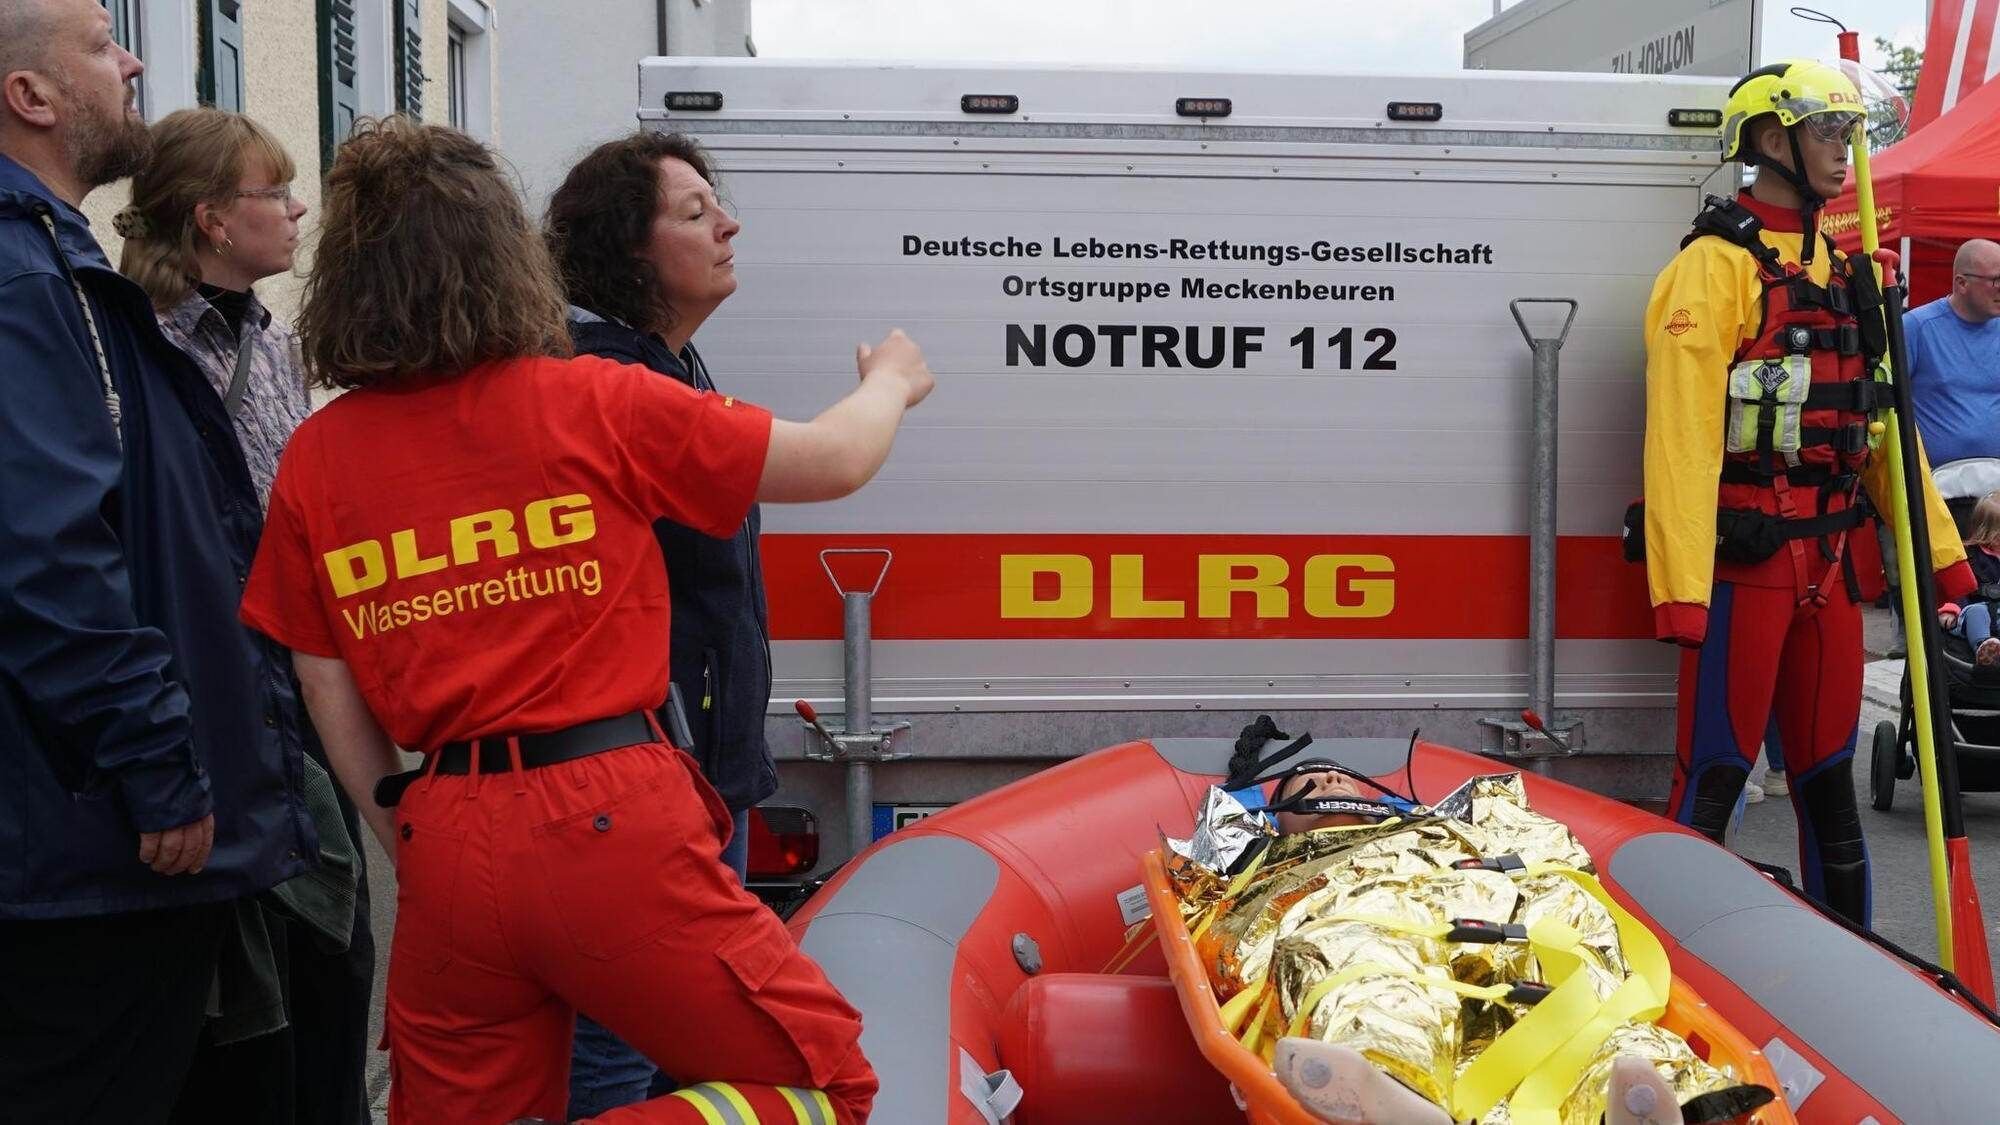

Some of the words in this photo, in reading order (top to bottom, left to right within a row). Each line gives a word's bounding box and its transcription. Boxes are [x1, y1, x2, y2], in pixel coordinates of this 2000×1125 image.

[1638, 25, 1694, 74] NOTRUF
[902, 235, 1042, 258] Deutsche
[1052, 237, 1493, 266] Lebens-Rettungs-Gesellschaft
[1002, 275, 1170, 302] Ortsgruppe
[1181, 278, 1395, 301] Meckenbeuren
[1005, 324, 1265, 369] NOTRUF
[1290, 327, 1397, 370] 112
[323, 493, 596, 598] DLRG
[342, 559, 602, 640] Wasserrettung
[1000, 554, 1395, 618] DLRG
